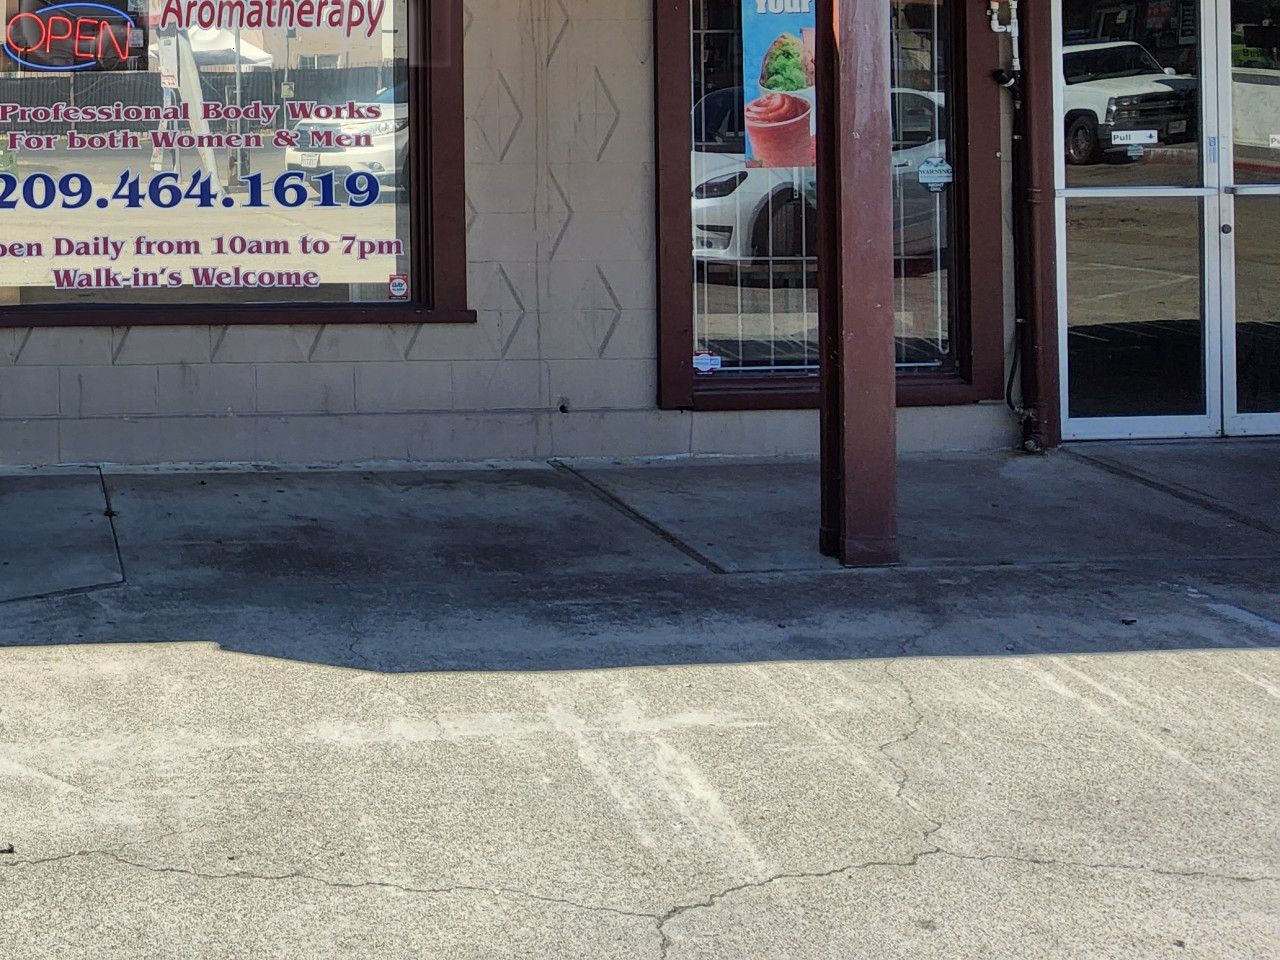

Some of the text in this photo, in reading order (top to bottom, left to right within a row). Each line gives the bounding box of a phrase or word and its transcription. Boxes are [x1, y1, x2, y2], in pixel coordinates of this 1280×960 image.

[6, 12, 131, 60] OPEN
[0, 101, 381, 123] Professional Body Works
[7, 130, 373, 150] For both Women & Men
[1113, 133, 1131, 141] Pull
[54, 237, 125, 260] Daily
[134, 237, 201, 256] from
[216, 236, 290, 256] 10am
[300, 236, 330, 254] to
[344, 236, 403, 260] 7pm
[191, 268, 319, 288] Welcome
